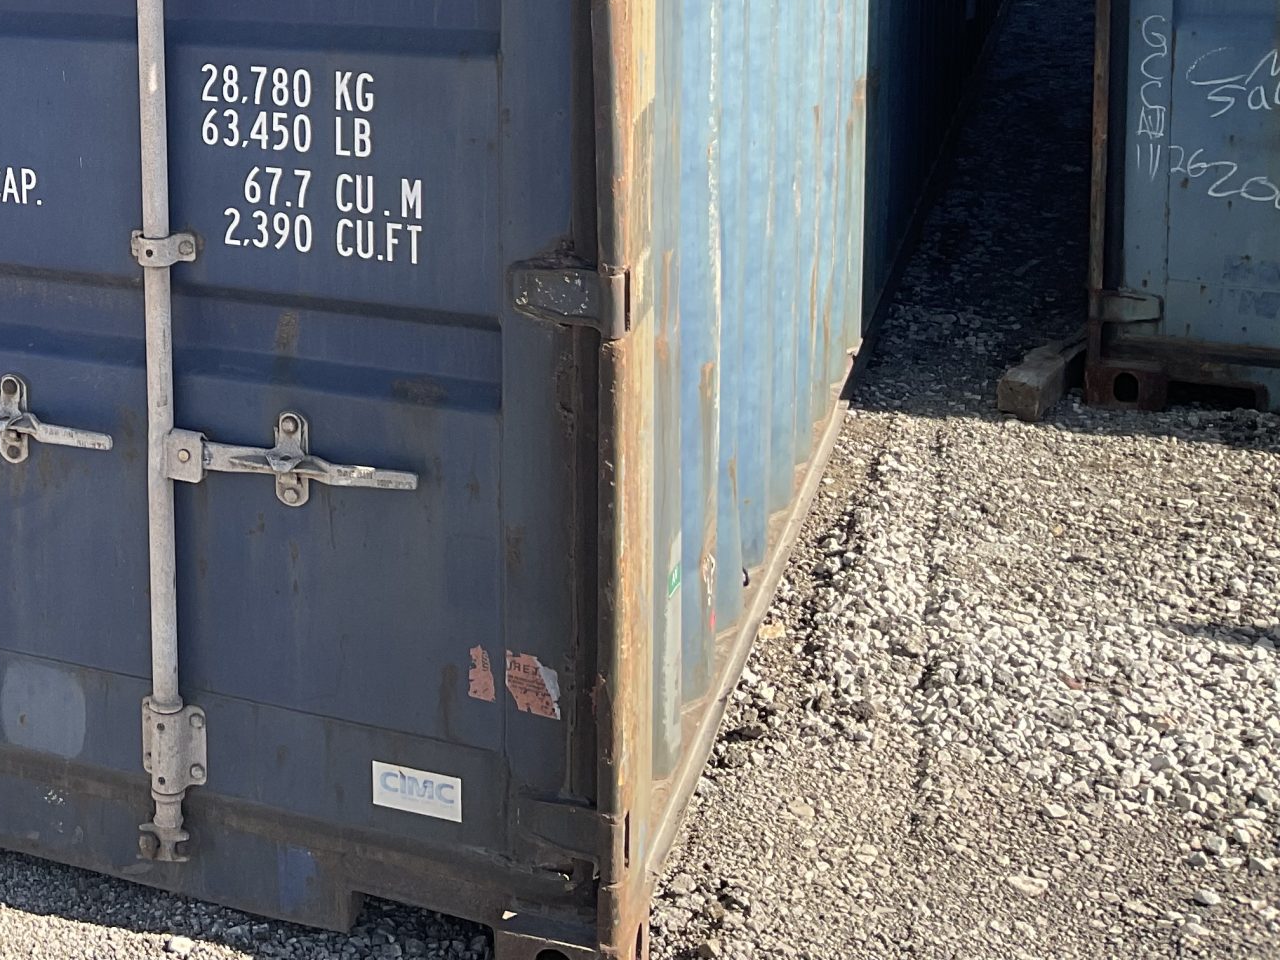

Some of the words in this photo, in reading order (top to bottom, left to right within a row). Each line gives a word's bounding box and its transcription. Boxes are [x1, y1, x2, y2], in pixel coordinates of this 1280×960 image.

[201, 63, 312, 108] 28,780
[335, 71, 375, 113] KG
[202, 108, 312, 154] 63,450
[335, 116, 372, 159] LB
[244, 166, 312, 209] 67.7
[224, 208, 313, 253] 2,390
